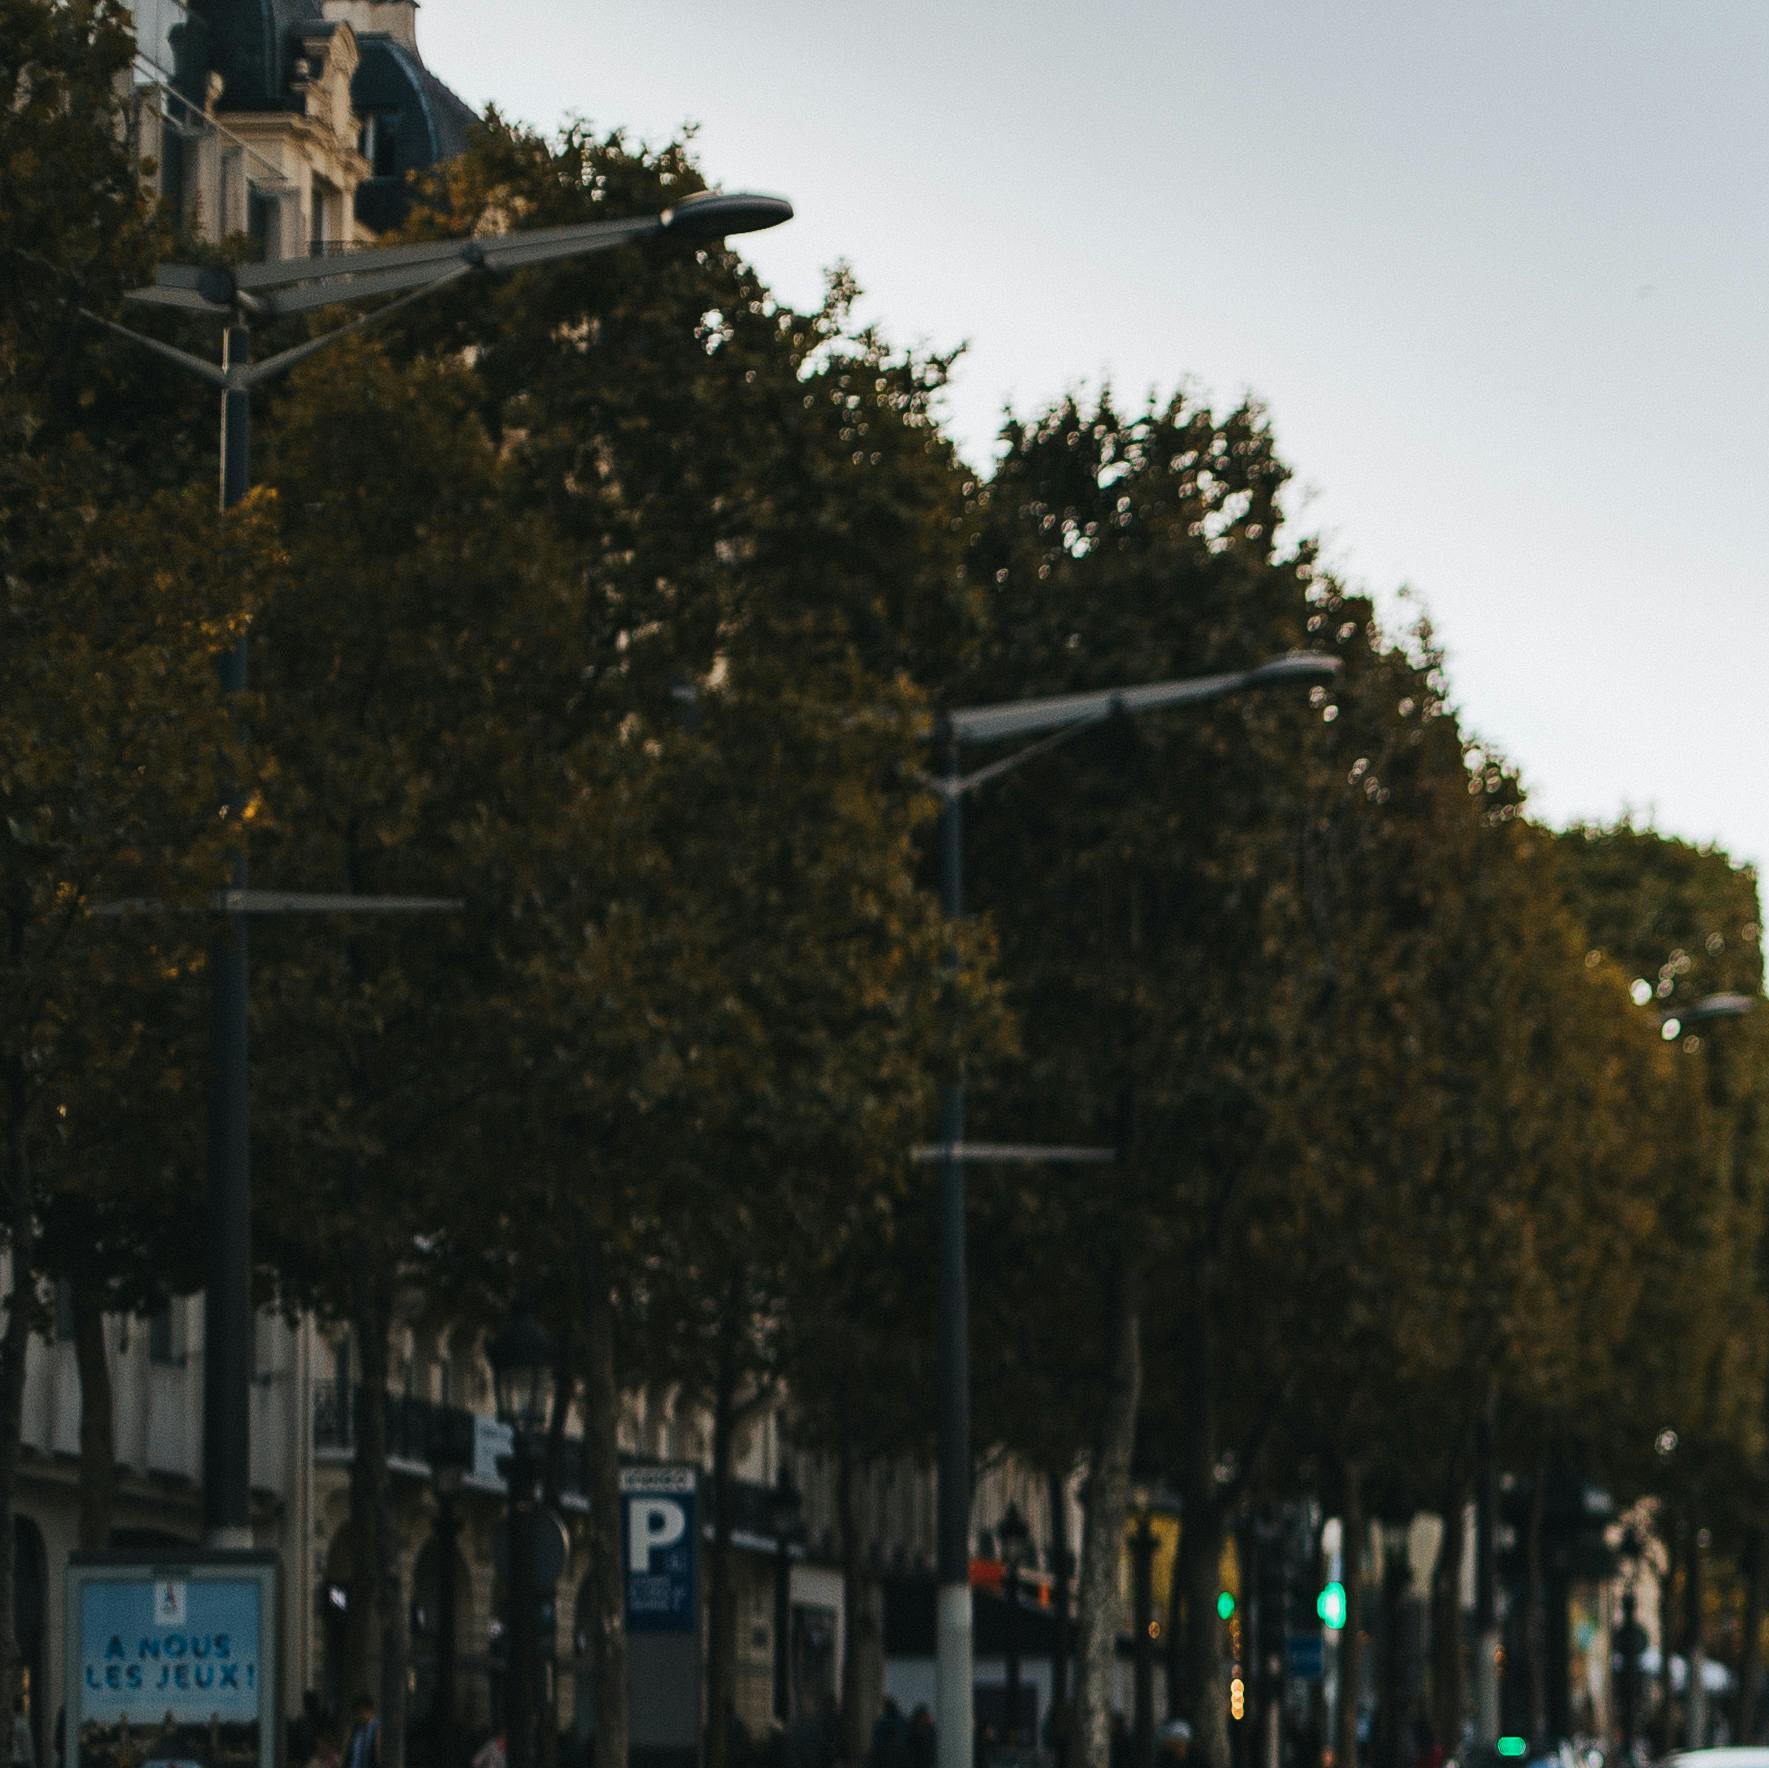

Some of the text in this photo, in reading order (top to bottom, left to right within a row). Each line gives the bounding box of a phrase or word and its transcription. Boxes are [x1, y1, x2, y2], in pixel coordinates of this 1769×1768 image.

[629, 1500, 685, 1571] P
[138, 1632, 230, 1660] NOUS
[86, 1664, 143, 1690] LES
